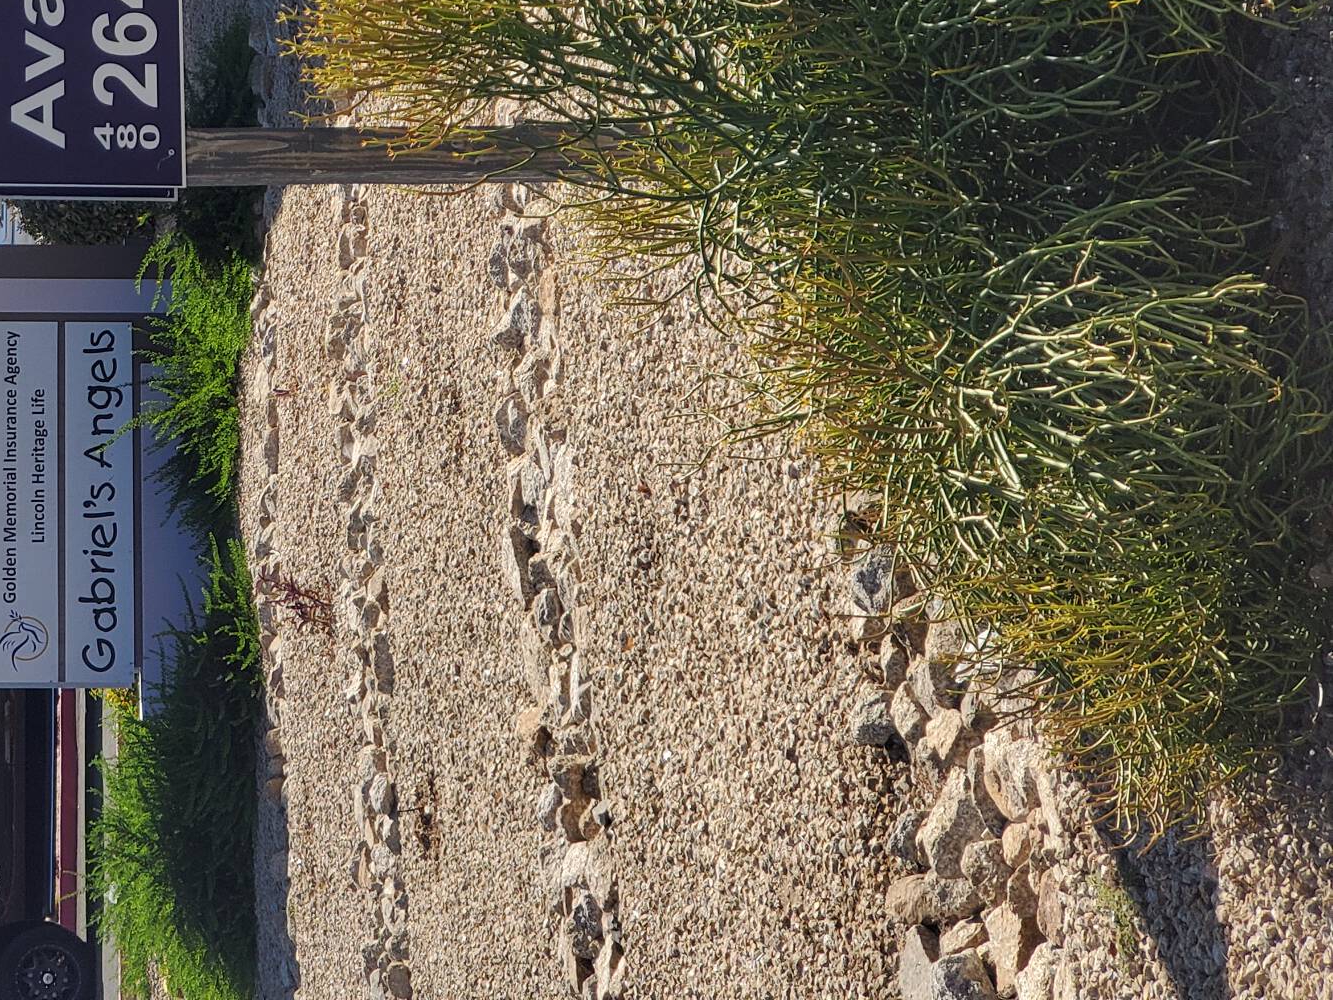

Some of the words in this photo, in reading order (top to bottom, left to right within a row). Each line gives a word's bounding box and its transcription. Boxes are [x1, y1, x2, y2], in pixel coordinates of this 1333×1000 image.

[4, 331, 20, 385] Agency
[4, 390, 17, 462] Insurance
[31, 389, 45, 414] Life
[83, 329, 123, 468] Angels
[31, 420, 48, 483] Heritage
[3, 468, 16, 542] Memorial
[31, 490, 45, 542] Lincoln
[2, 548, 16, 603] Golden
[78, 479, 117, 672] Gabriel's
